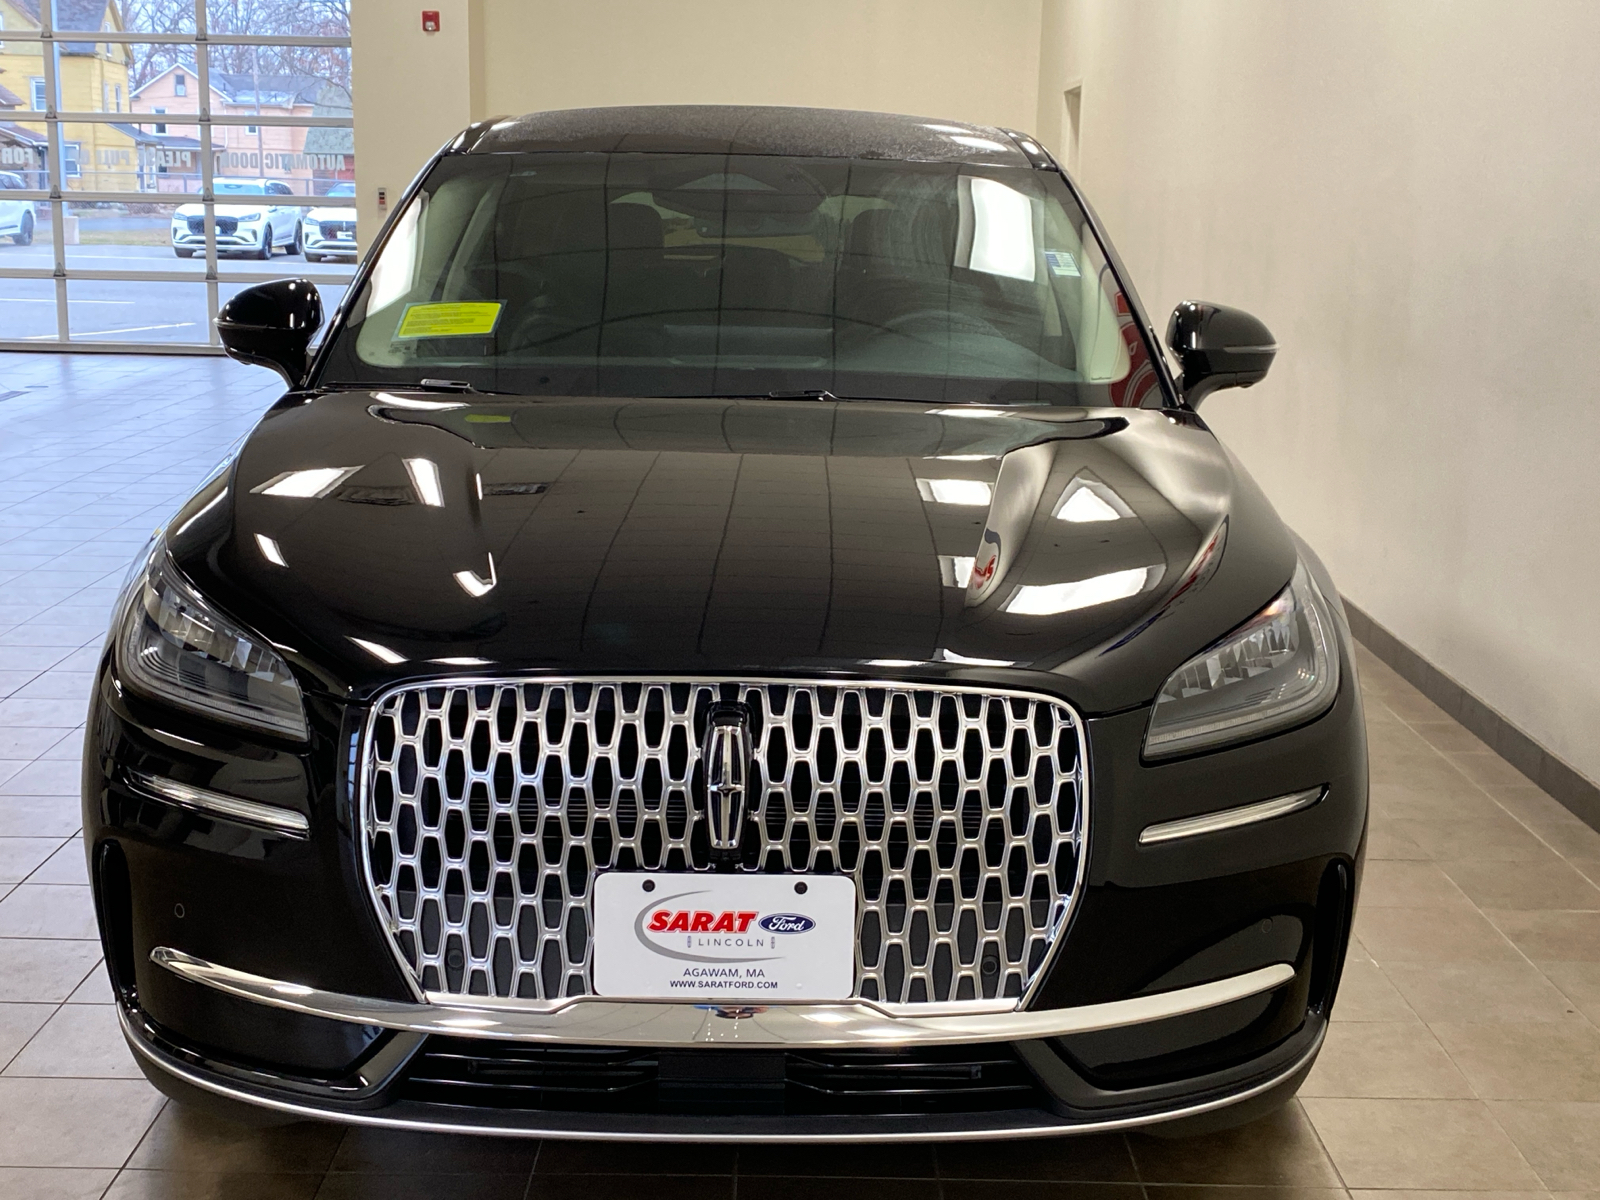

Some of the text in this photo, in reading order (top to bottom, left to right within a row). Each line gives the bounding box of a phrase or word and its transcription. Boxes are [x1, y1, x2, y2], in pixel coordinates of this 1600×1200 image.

[647, 910, 806, 934] SARAT Ford
[698, 938, 764, 947] LINCOLN
[683, 968, 766, 980] AGAWAM, MA
[670, 980, 778, 990] WWW.SARATFORD.COM
